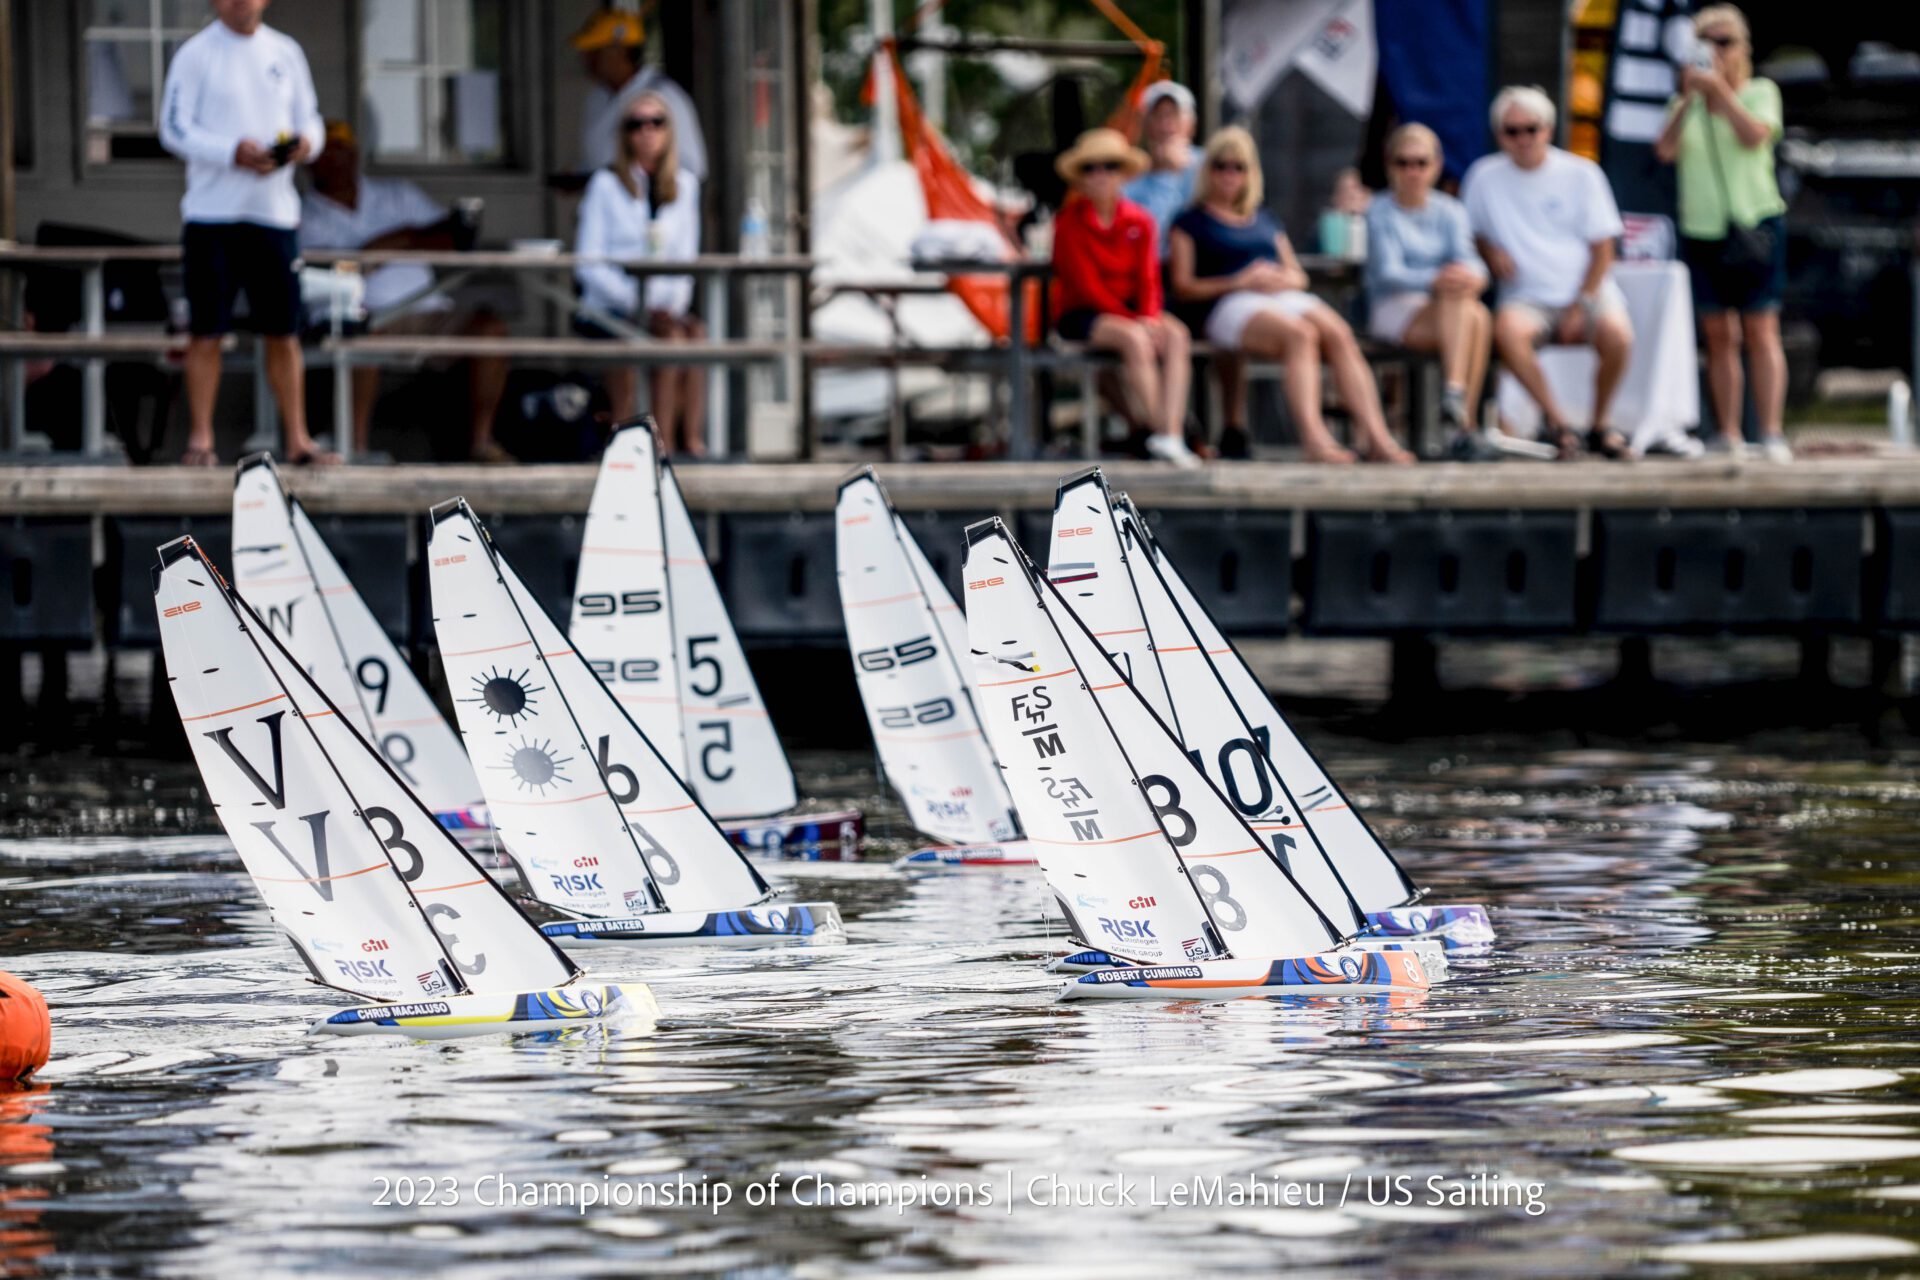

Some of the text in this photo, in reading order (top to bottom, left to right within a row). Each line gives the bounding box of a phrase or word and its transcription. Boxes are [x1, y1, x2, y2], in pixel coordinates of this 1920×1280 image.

[578, 591, 662, 616] 95
[687, 634, 723, 697] 5
[356, 655, 389, 714] 9
[1033, 733, 1066, 759] M
[203, 710, 286, 810] V
[598, 734, 640, 804] 6
[574, 856, 599, 868] Gill
[550, 873, 604, 896] RISK
[1129, 896, 1157, 910] Gill
[576, 919, 643, 933] BARR BATZER
[1098, 917, 1156, 942] RISK
[361, 939, 390, 952] Gill
[1139, 949, 1163, 958] GROUP
[1185, 947, 1203, 957] US
[334, 959, 393, 983] RISK
[1097, 966, 1200, 983] ROBERT CUMMINGS
[1403, 958, 1420, 983] 8
[422, 980, 441, 992] US
[357, 1001, 448, 1020] CHRIS MACALUSO
